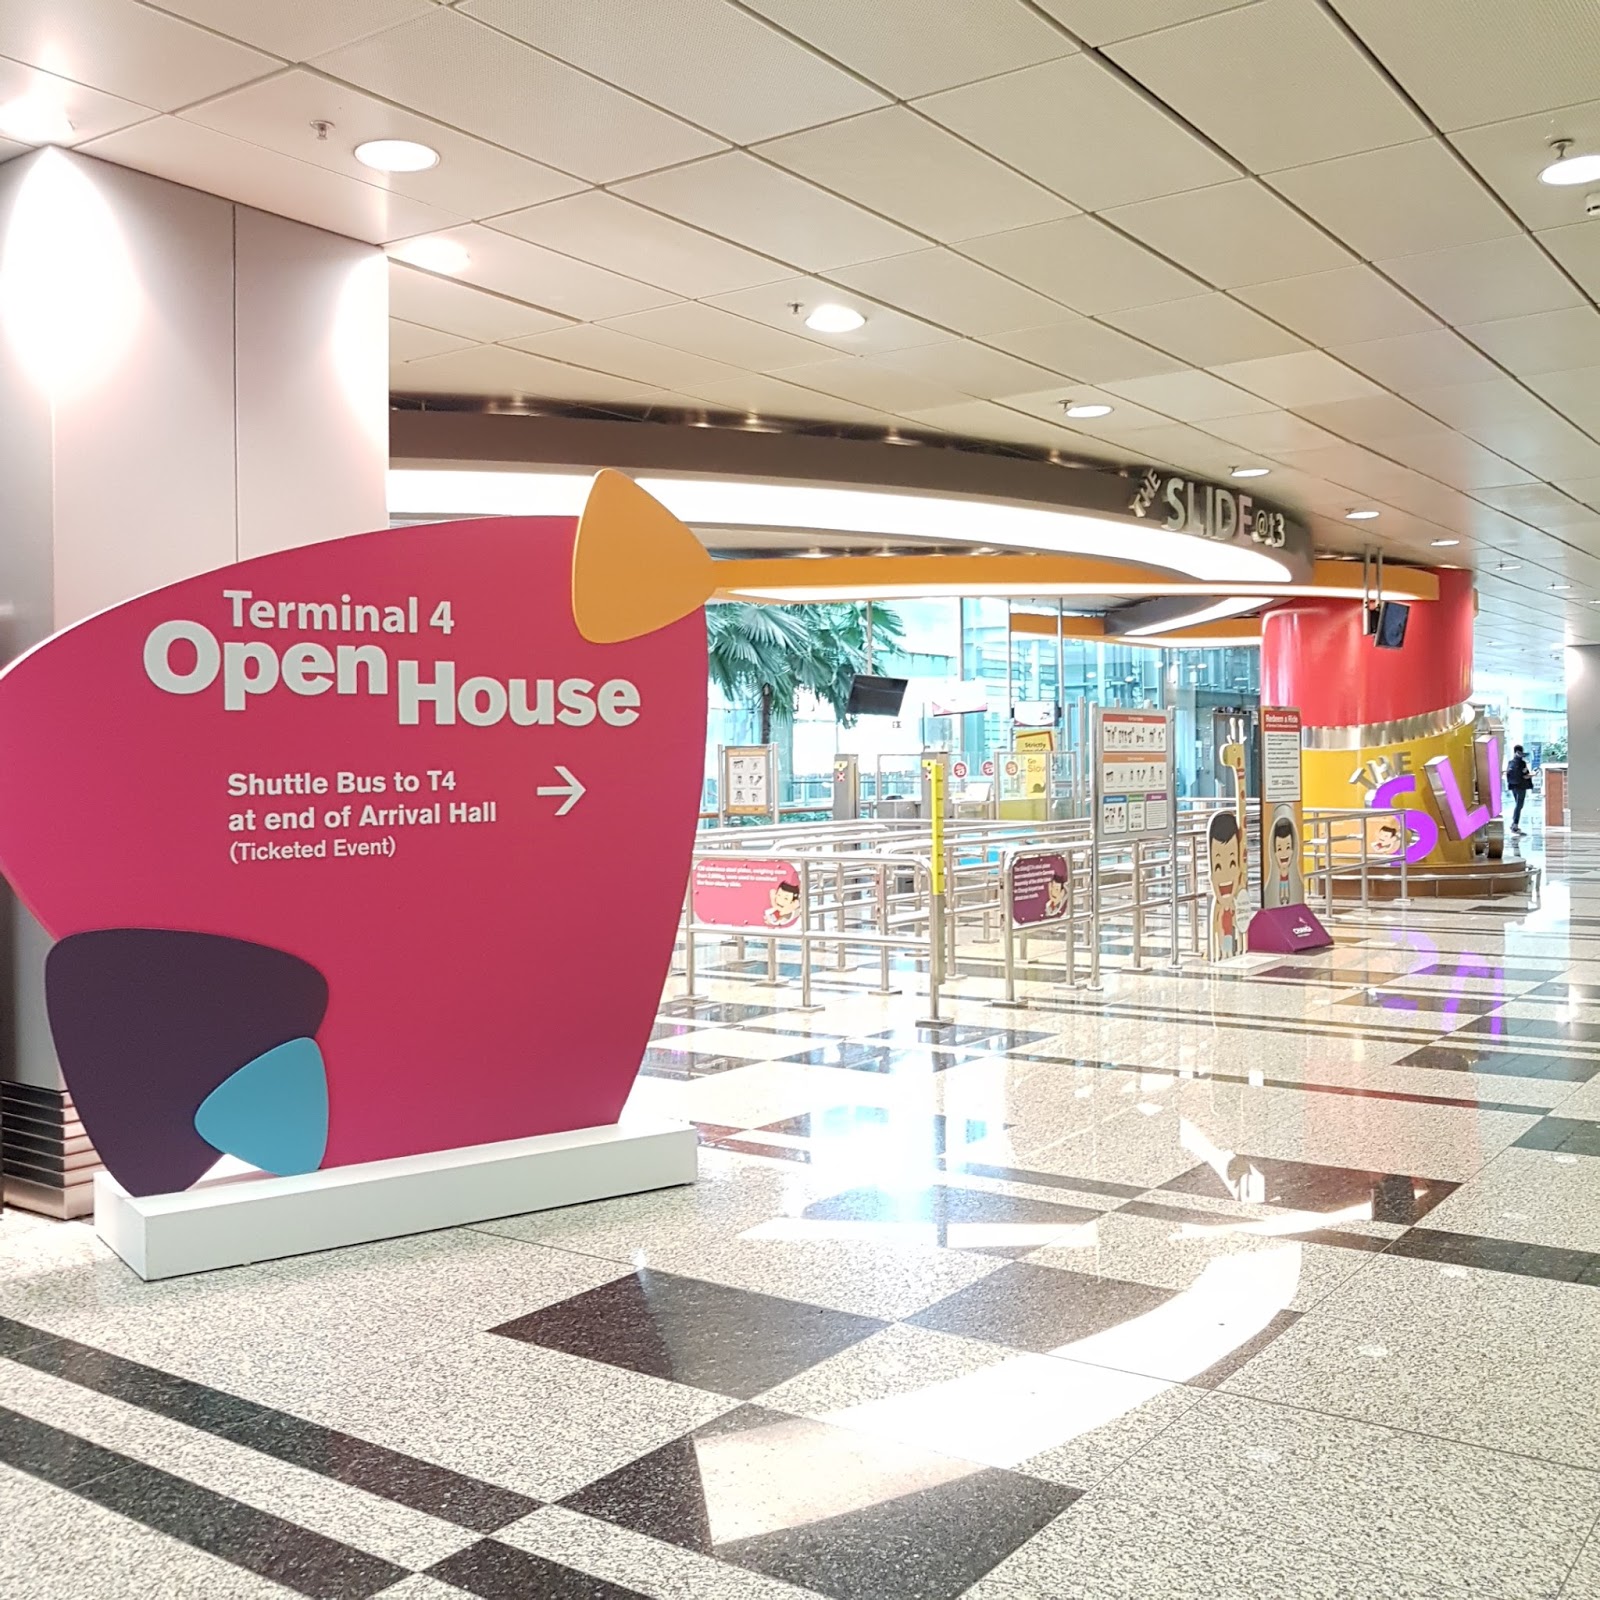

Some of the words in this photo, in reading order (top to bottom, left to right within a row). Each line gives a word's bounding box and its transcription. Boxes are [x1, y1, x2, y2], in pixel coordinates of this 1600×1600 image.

[1128, 468, 1161, 518] THE
[223, 589, 418, 634] Terminal
[429, 600, 455, 635] 4
[143, 619, 388, 711] Open
[397, 659, 641, 727] House
[227, 772, 329, 797] Shuttle
[337, 771, 387, 794] Bus
[393, 771, 420, 792] to
[426, 770, 457, 791] T4
[1349, 751, 1412, 790] THE
[228, 809, 256, 832] at
[264, 806, 315, 831] end
[324, 805, 352, 828] of
[358, 802, 441, 827] Arrival
[449, 801, 497, 824] Hall
[229, 839, 326, 865] (Ticketed
[333, 835, 396, 858] Event)
